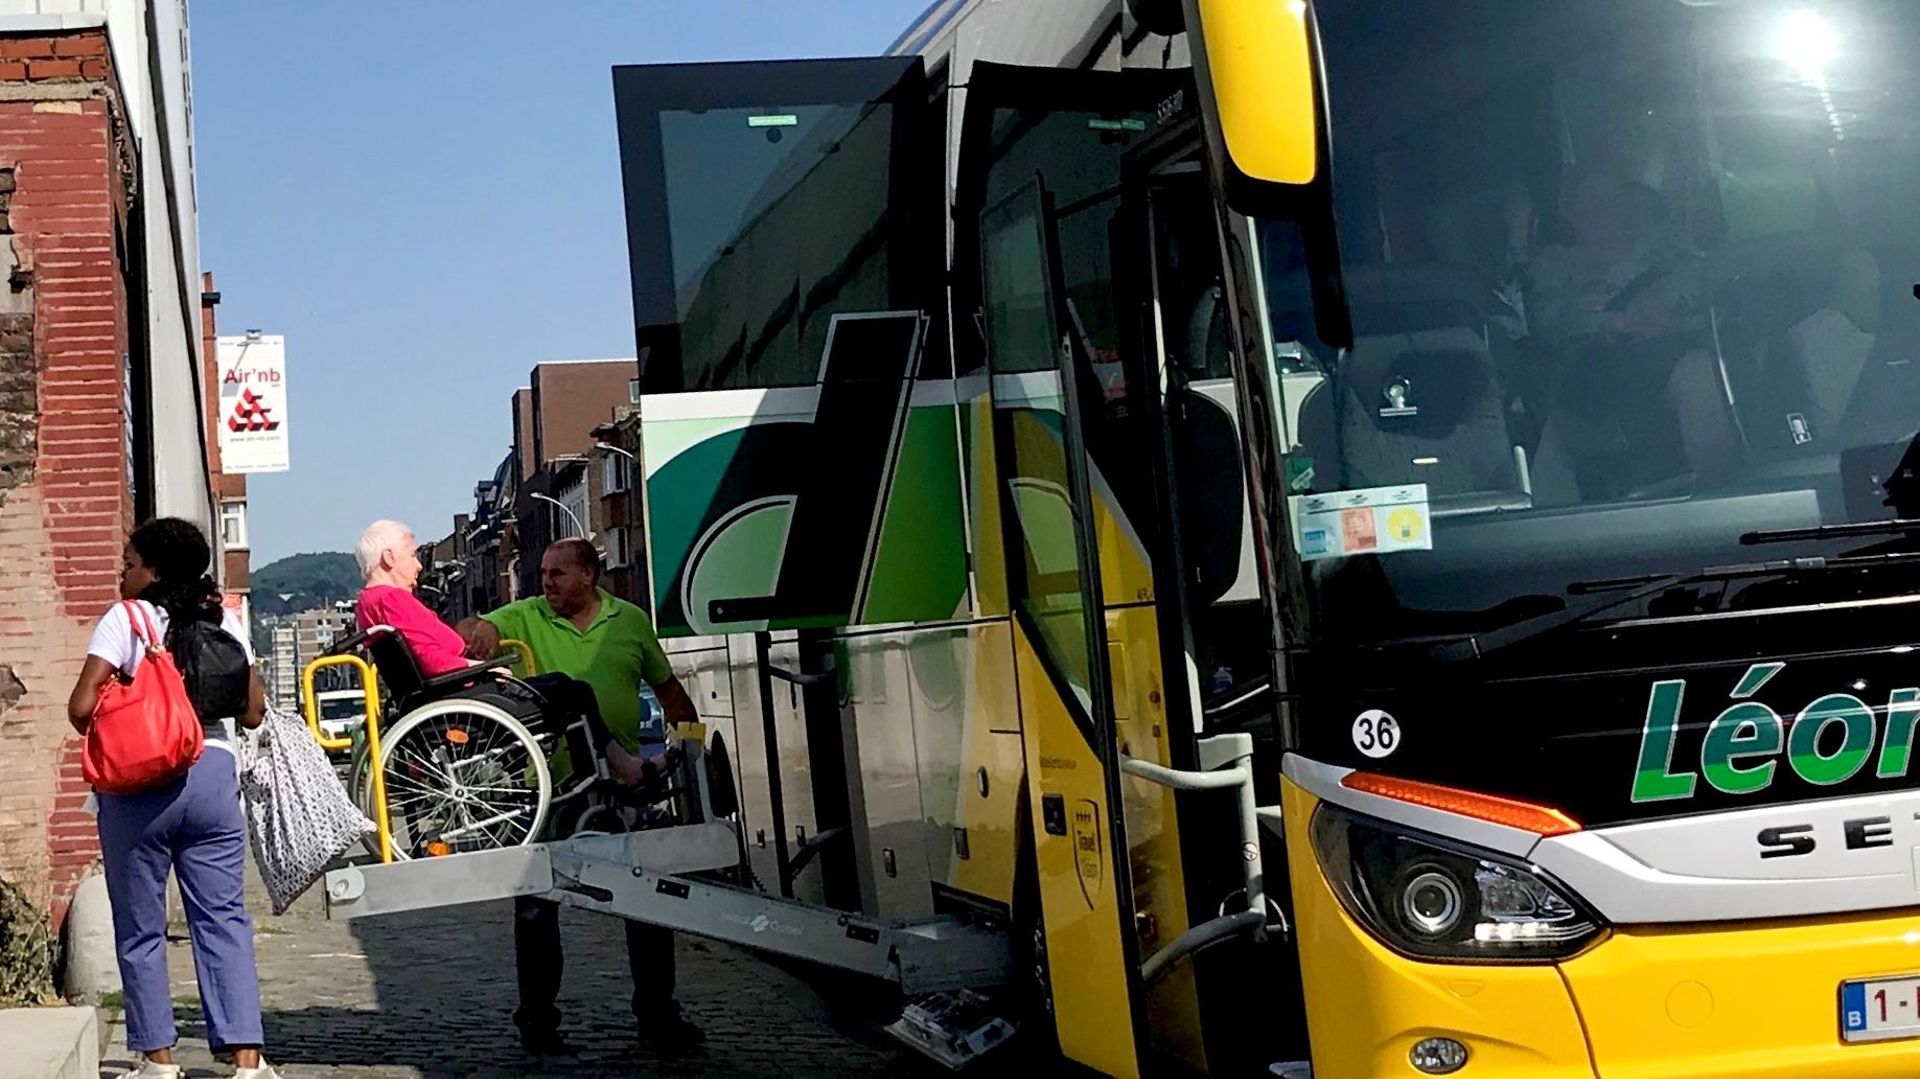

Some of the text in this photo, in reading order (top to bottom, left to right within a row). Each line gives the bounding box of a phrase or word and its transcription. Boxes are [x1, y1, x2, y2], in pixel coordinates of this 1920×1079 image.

[1359, 716, 1394, 750] 36
[1757, 811, 1920, 859] SE
[1848, 985, 1920, 1027] B 1-
